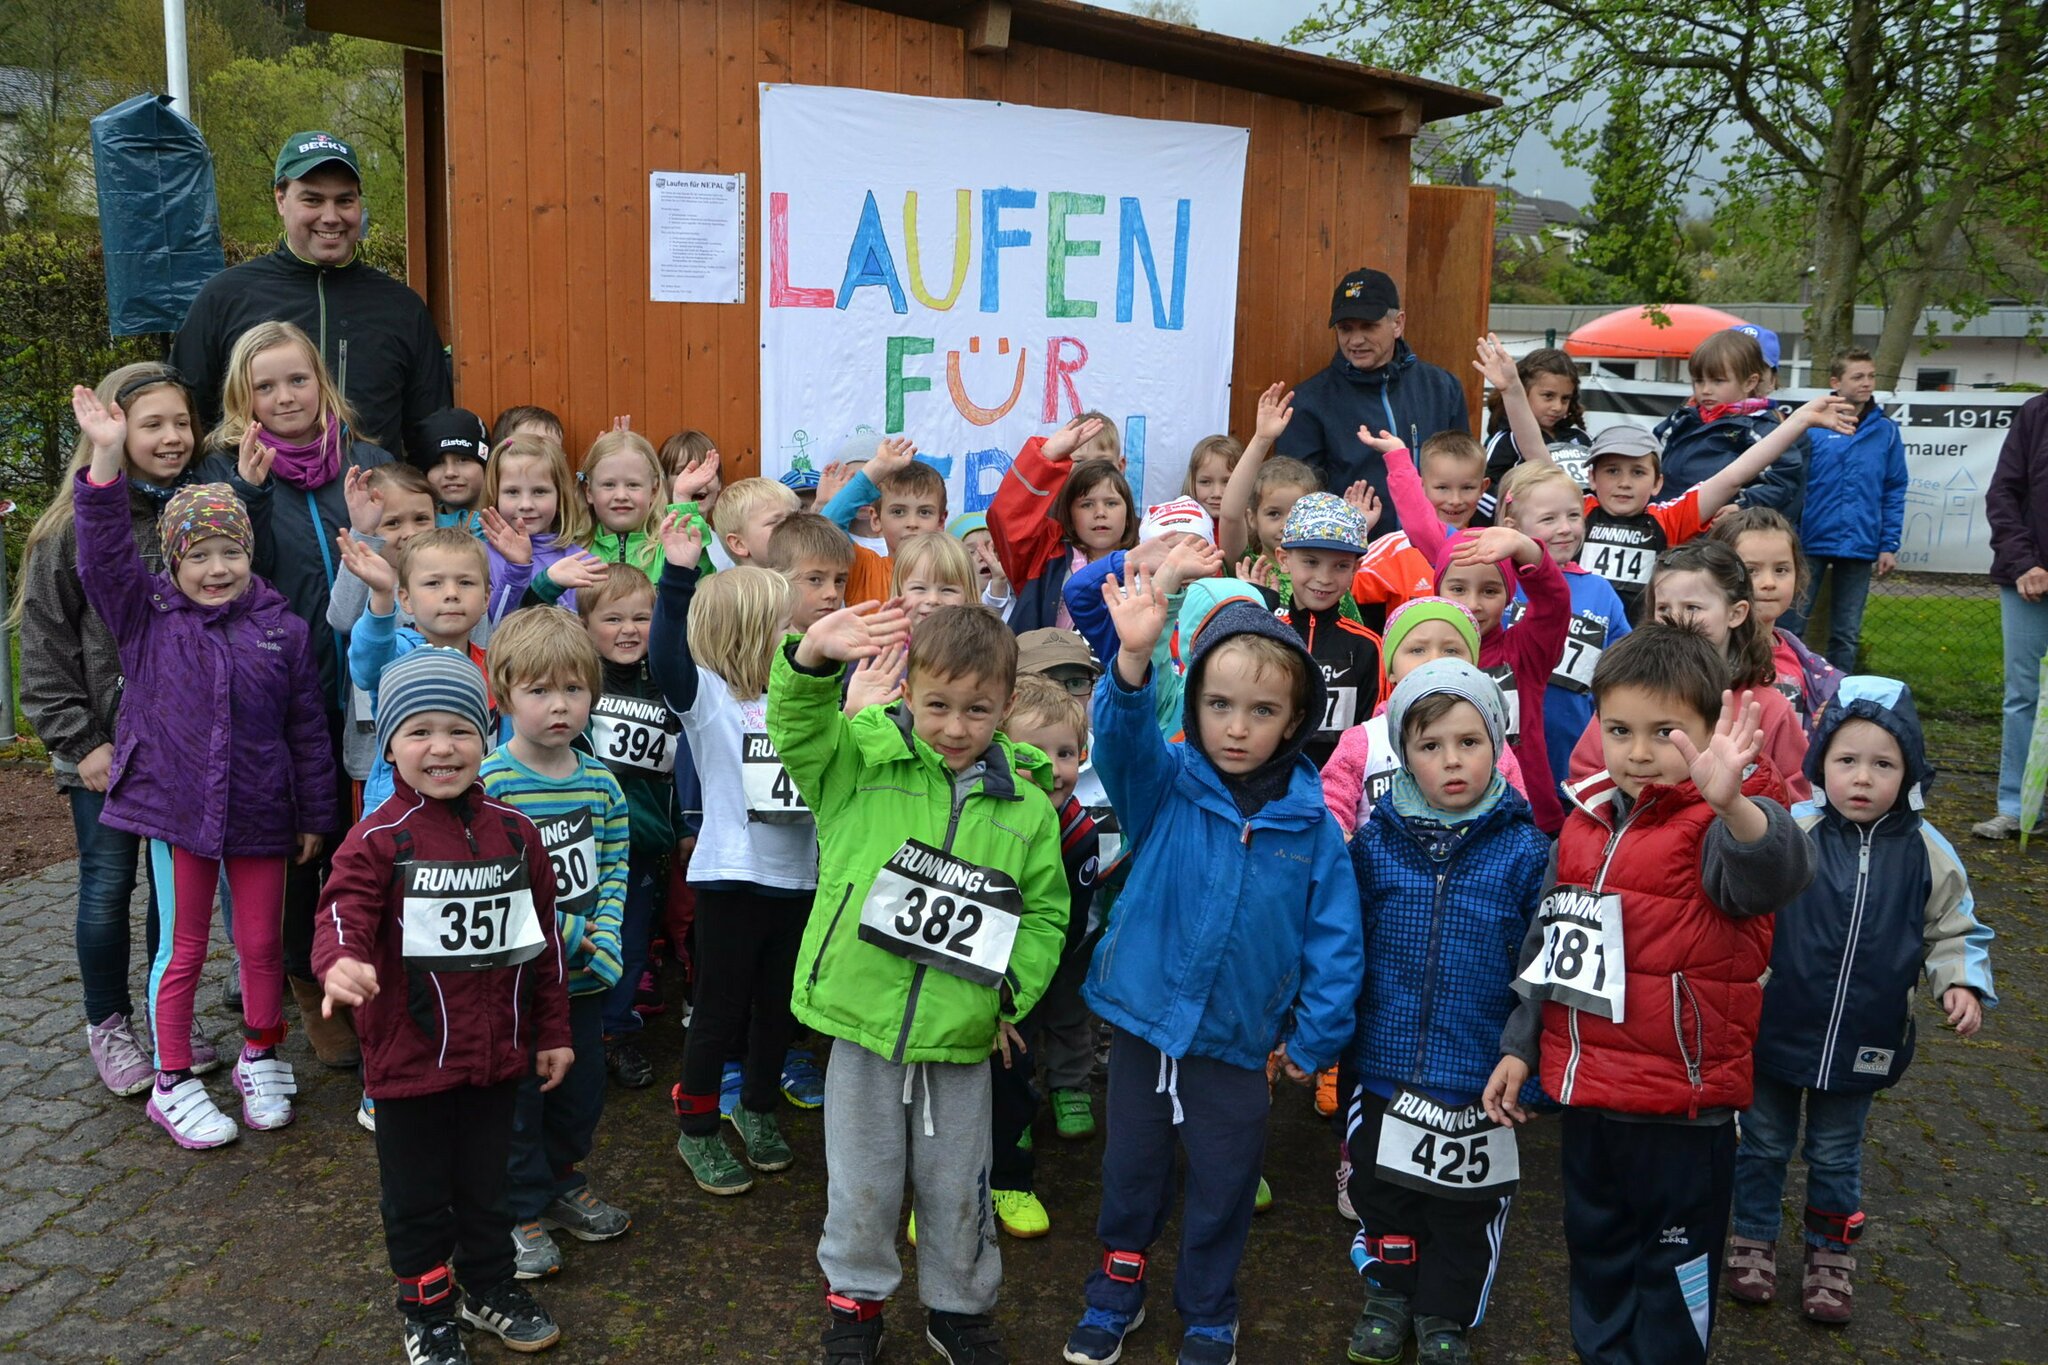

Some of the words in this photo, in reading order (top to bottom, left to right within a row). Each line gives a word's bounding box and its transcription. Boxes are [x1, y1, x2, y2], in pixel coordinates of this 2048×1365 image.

[298, 141, 348, 155] BECK'S
[666, 180, 689, 188] Laufen
[769, 186, 1191, 330] LAUFEN
[885, 335, 1089, 434] FÜR
[1943, 409, 2013, 428] 1915
[1904, 443, 1968, 457] mauer
[1588, 525, 1642, 545] RUNNING
[1594, 546, 1642, 580] 414
[595, 696, 667, 724] RUNNING
[609, 722, 666, 768] 394
[412, 864, 502, 891] RUNNING
[891, 844, 985, 893] RUNNING
[439, 896, 511, 952] 357
[894, 887, 983, 958] 382
[1393, 1091, 1476, 1132] RUNNING
[1411, 1133, 1490, 1184] 425
[1659, 1236, 1689, 1245] adidas
